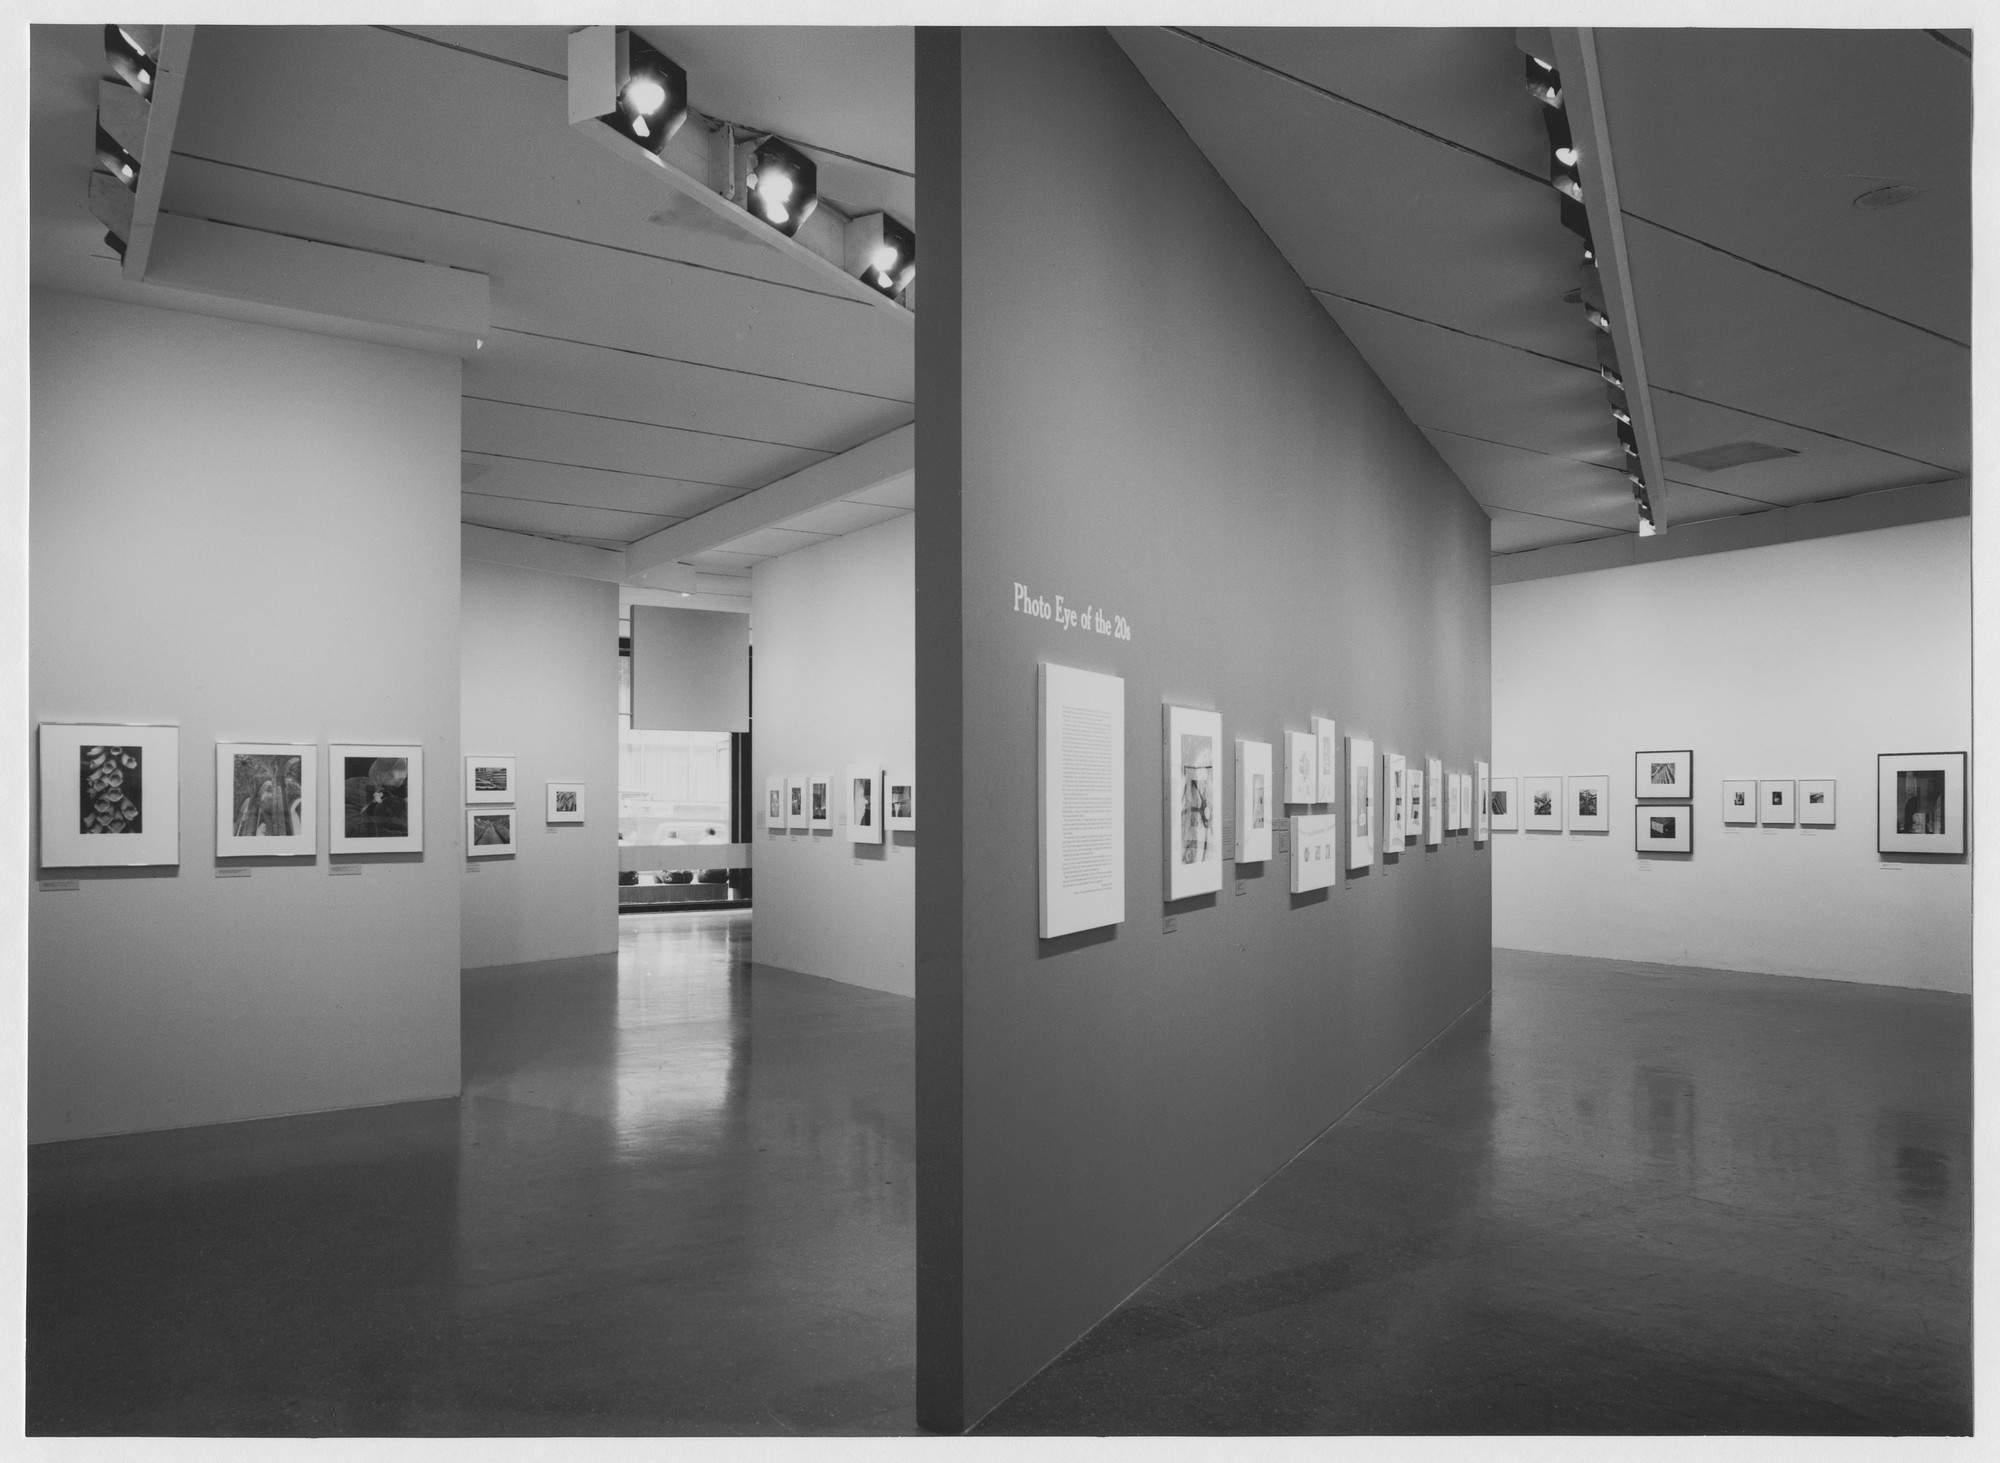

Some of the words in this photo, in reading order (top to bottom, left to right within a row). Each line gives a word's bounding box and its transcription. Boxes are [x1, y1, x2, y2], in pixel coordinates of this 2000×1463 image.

[1014, 582, 1051, 620] Photo
[1055, 595, 1078, 630] Eye
[1081, 605, 1093, 630] of
[1095, 608, 1112, 635] the
[1114, 614, 1131, 641] 20s
